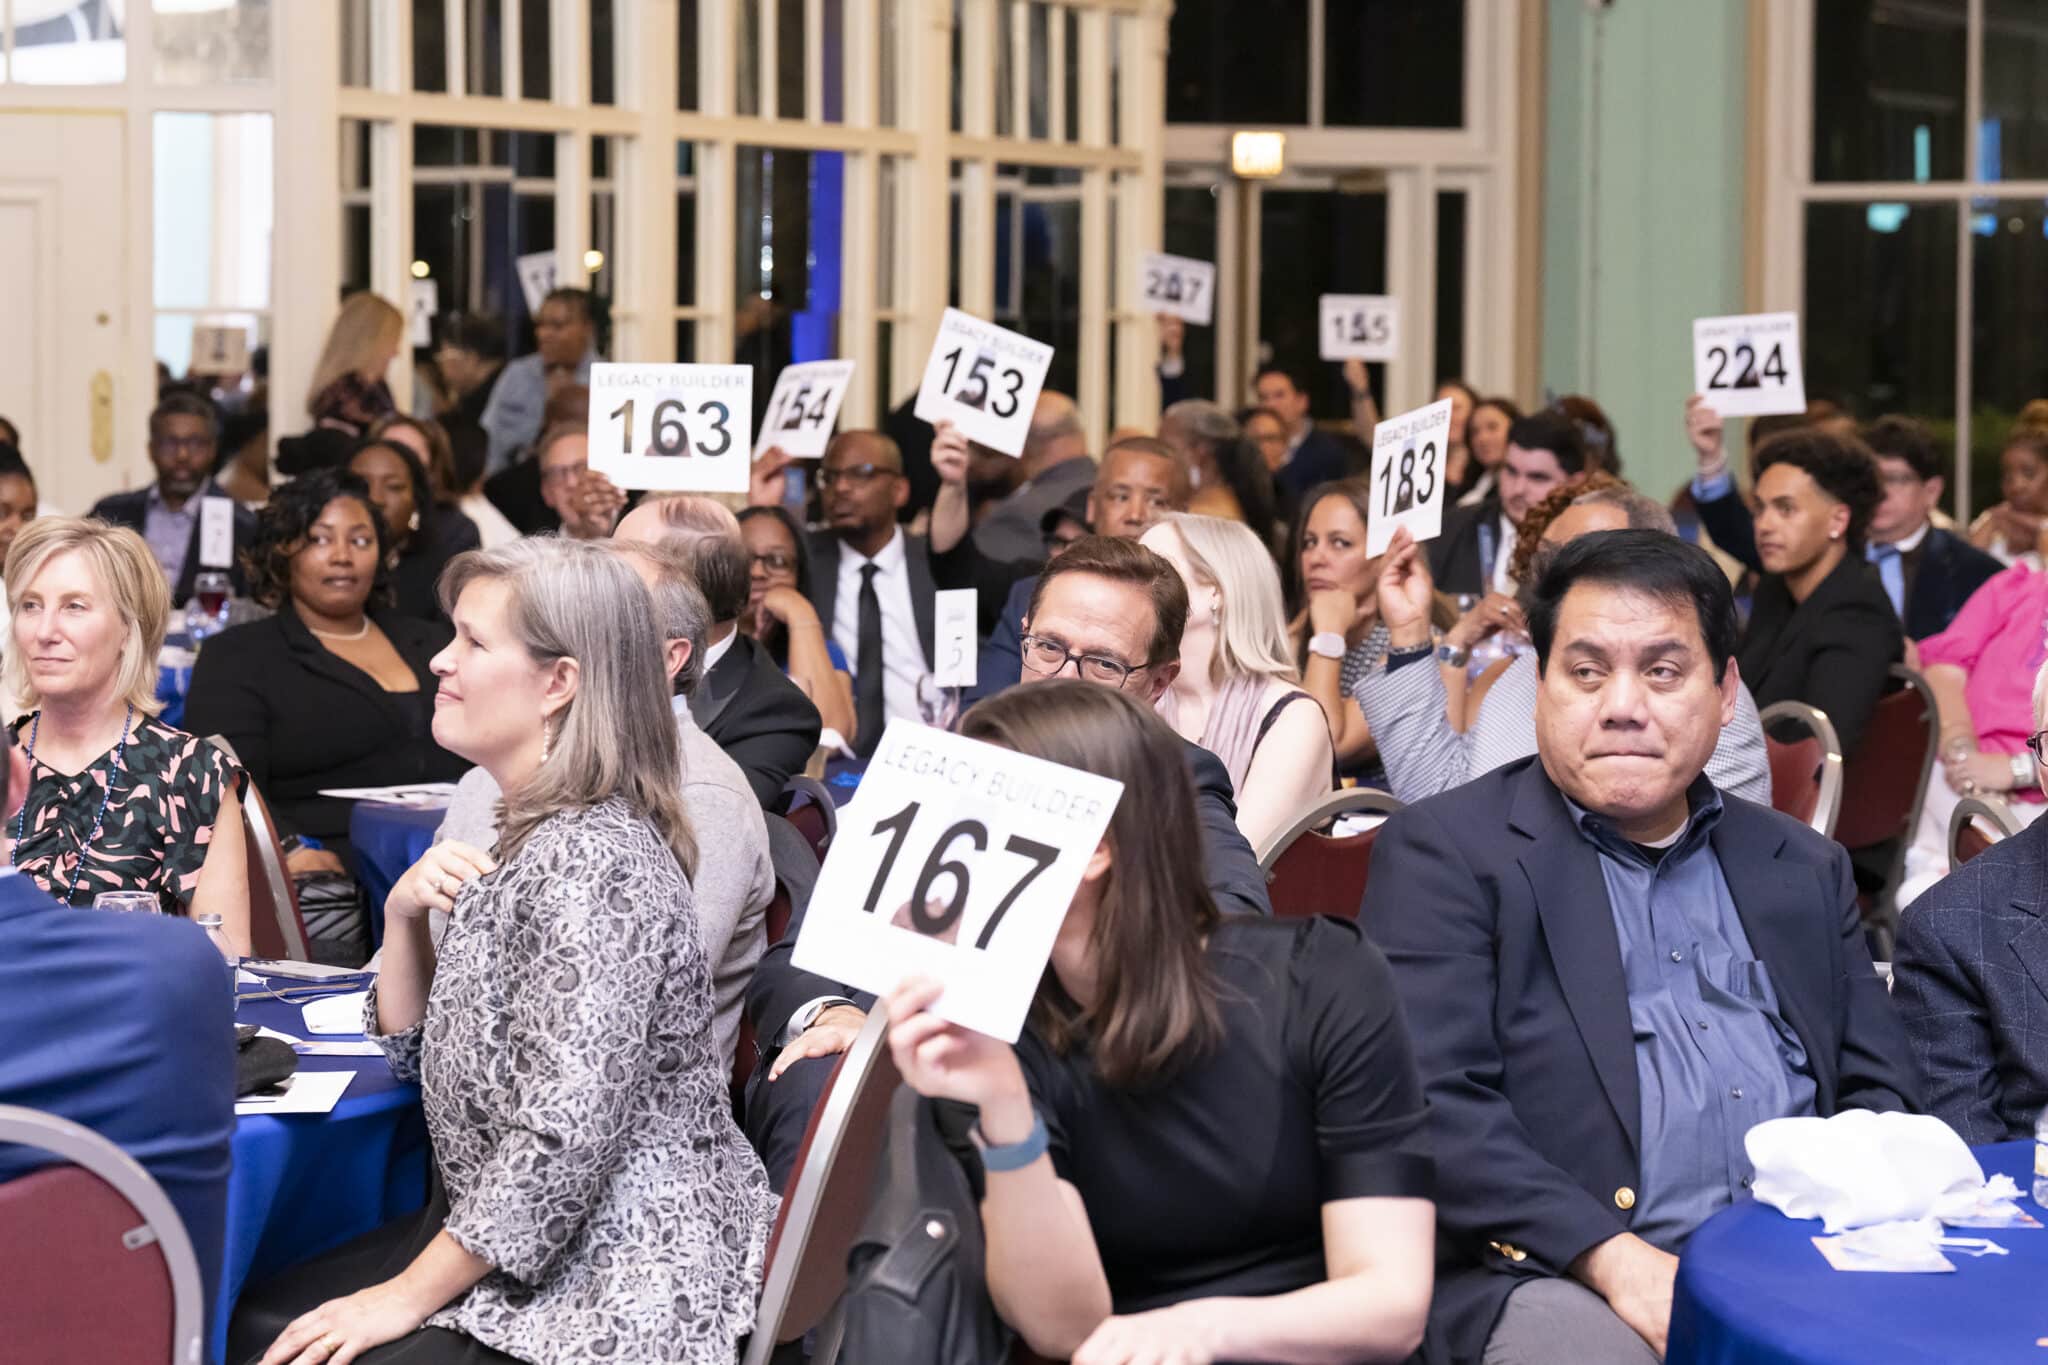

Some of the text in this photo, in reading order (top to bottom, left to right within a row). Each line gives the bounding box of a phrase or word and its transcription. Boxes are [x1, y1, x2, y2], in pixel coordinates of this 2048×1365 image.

[598, 374, 745, 388] LEGACY BUILDER
[943, 347, 1024, 418] 153
[1708, 343, 1788, 389] 224
[610, 399, 731, 457] 163
[772, 388, 833, 430] 154
[1411, 410, 1448, 435] BUILDER
[1380, 441, 1436, 517] 183
[881, 745, 1102, 821] LEGACY BUILDER
[862, 801, 1061, 950] 167
